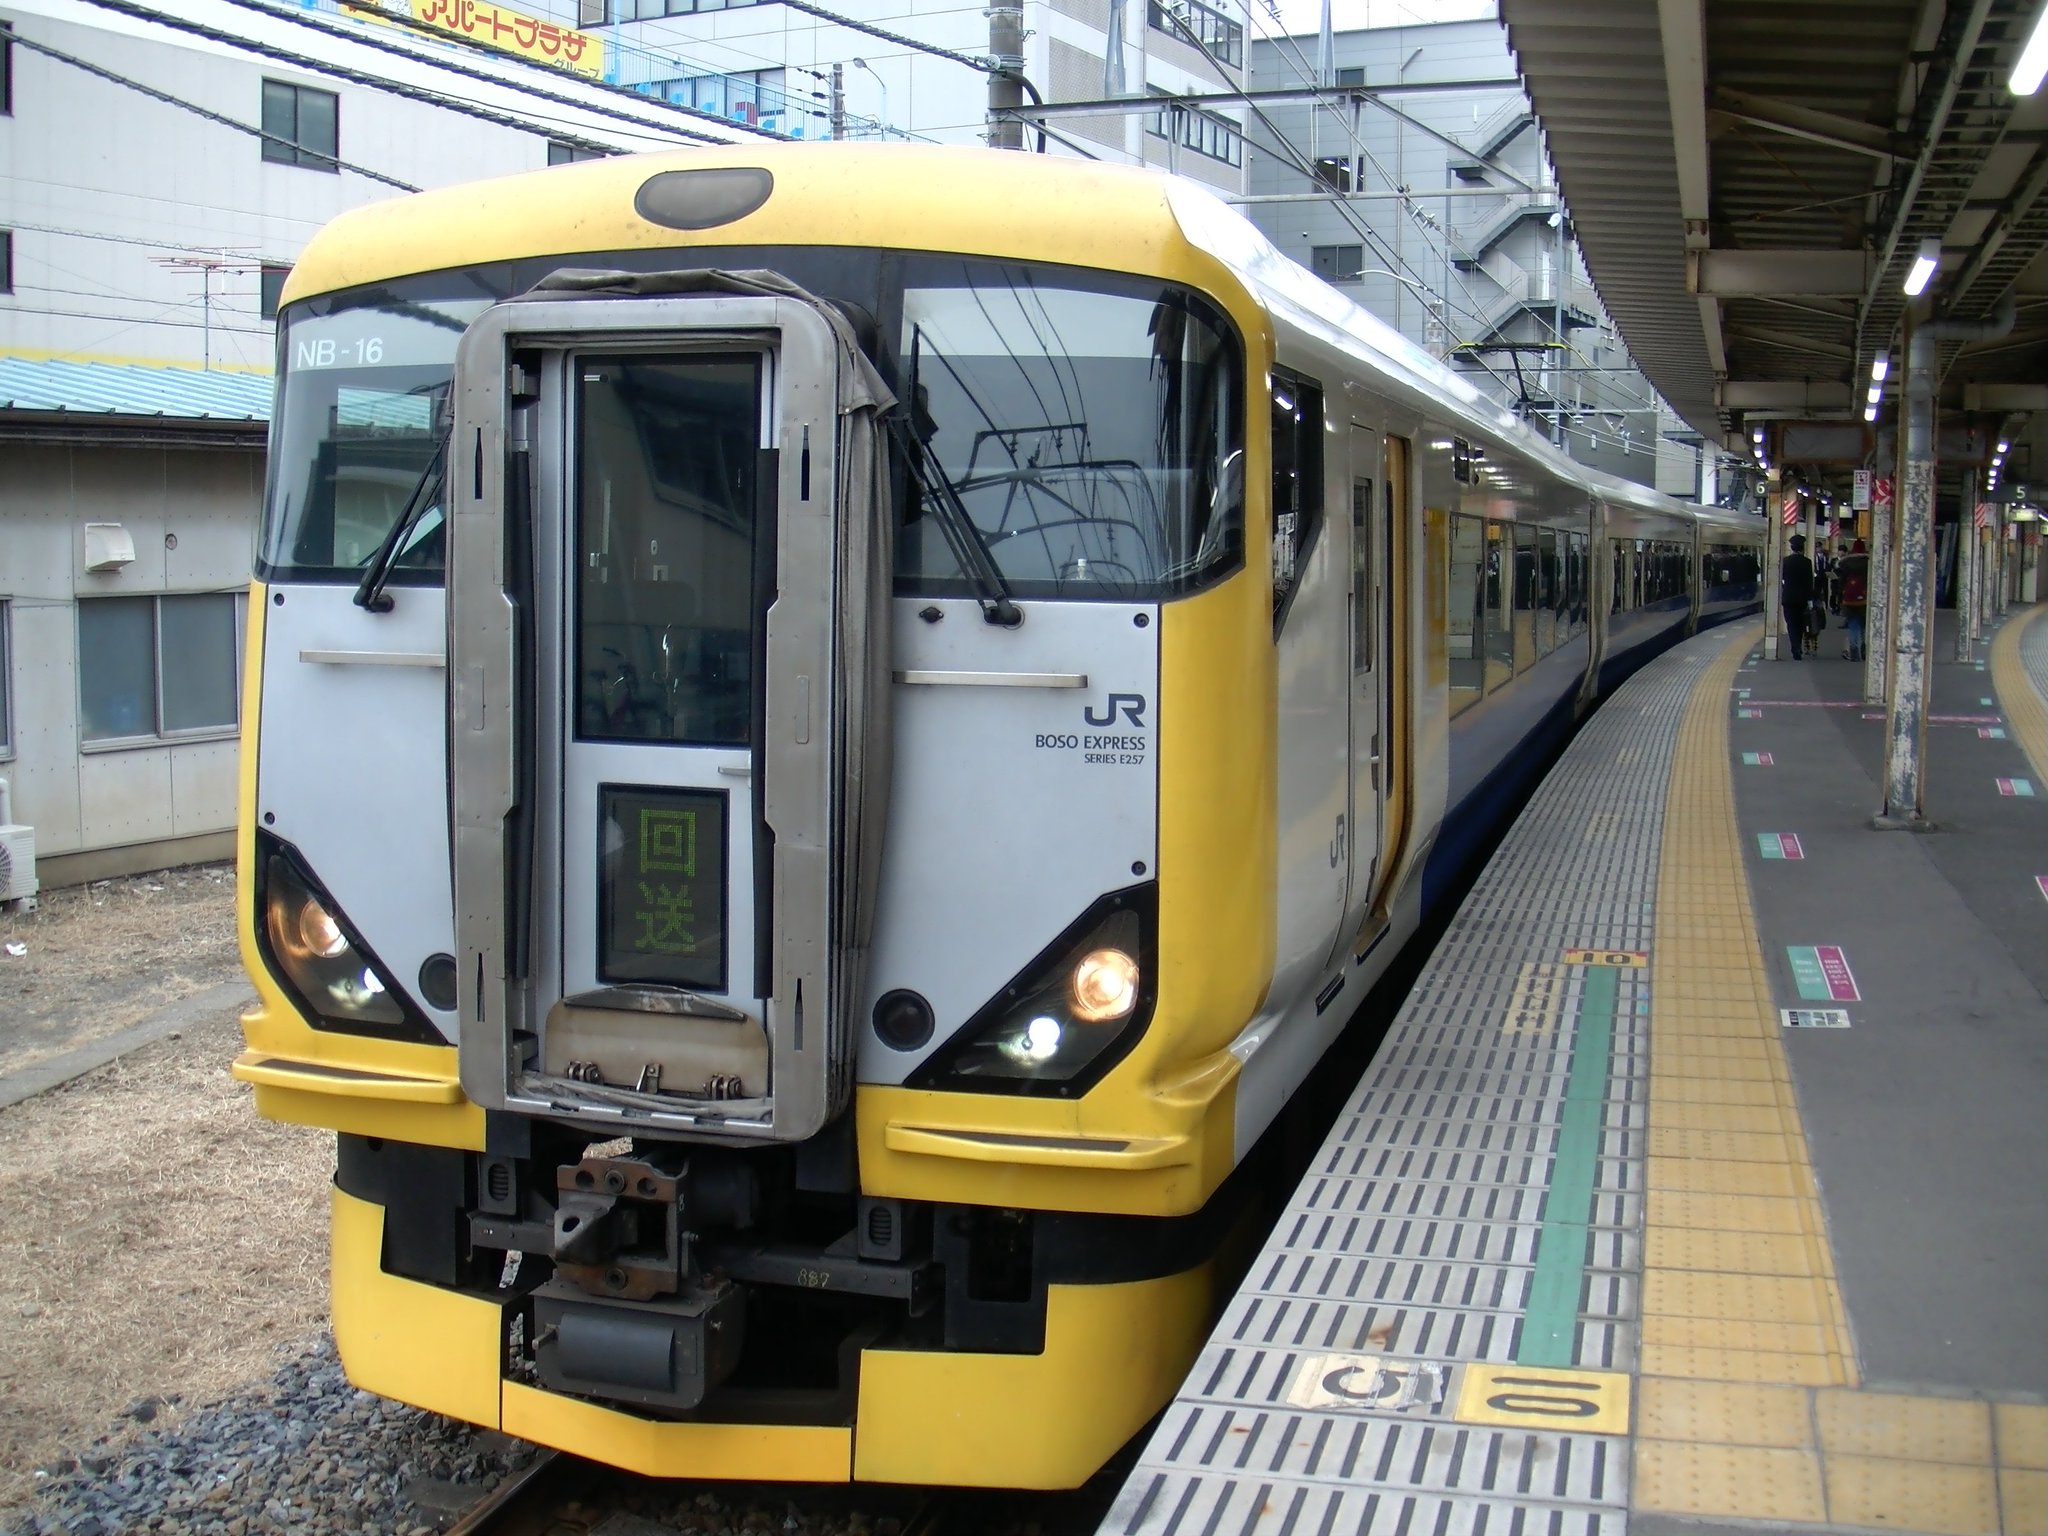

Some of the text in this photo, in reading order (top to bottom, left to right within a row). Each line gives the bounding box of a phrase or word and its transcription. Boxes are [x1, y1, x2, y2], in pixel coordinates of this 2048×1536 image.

[1756, 481, 1766, 495] 6
[2016, 485, 2026, 499] 5
[1084, 693, 1147, 728] JR
[1035, 734, 1146, 751] BOSO EXPRESS
[1084, 753, 1145, 765] SERIES E257
[1330, 813, 1345, 869] JR
[634, 808, 697, 953] 回送
[1486, 1376, 1602, 1418] 10
